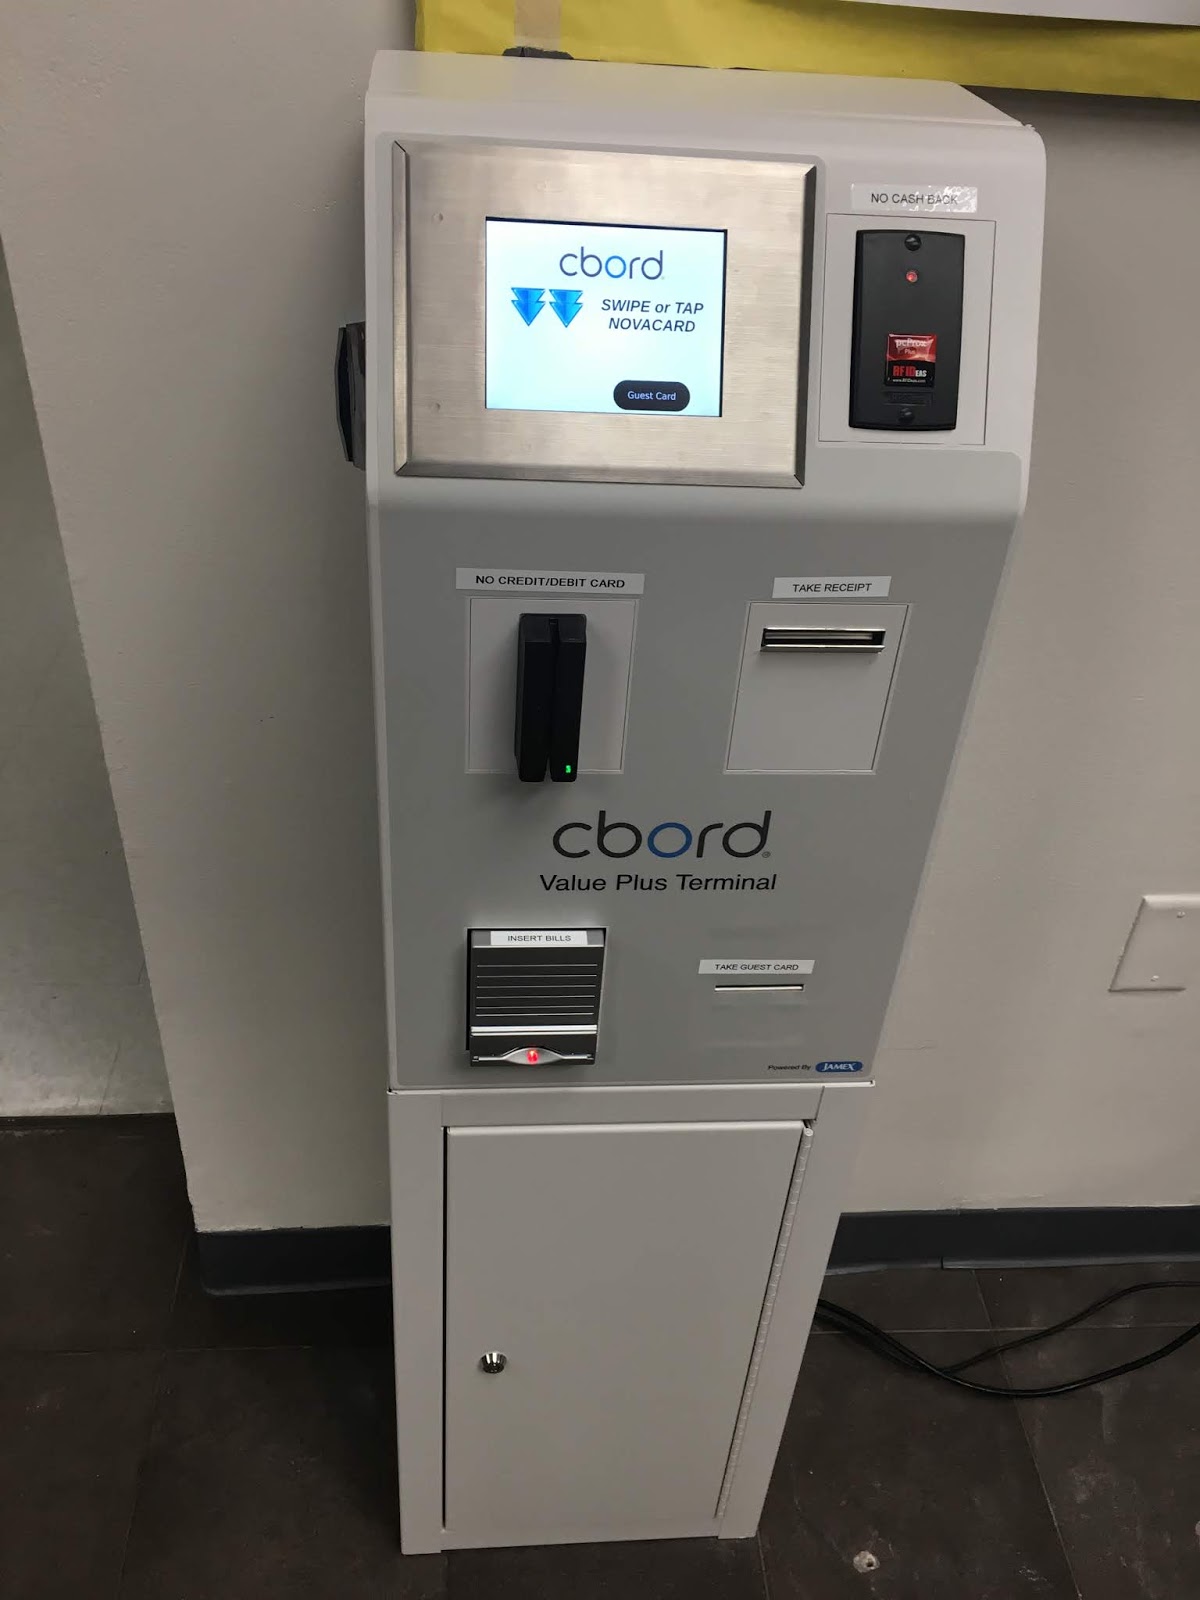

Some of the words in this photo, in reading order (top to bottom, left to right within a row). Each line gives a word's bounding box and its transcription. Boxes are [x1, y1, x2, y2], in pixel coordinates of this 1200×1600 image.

[870, 193, 889, 204] NO
[891, 193, 924, 204] CASH
[927, 194, 958, 205] BACK
[559, 246, 664, 280] cbord
[601, 298, 651, 313] SWIPE
[654, 302, 670, 314] or
[675, 302, 704, 315] TAP
[608, 317, 696, 332] NOVACARD
[627, 390, 653, 401] Guest
[656, 391, 677, 401] Card
[475, 575, 495, 585] NO
[498, 576, 587, 587] CREDIT/DEBIT
[590, 578, 625, 588] CARD
[792, 583, 822, 593] TAKE
[824, 582, 873, 592] RECEIPT
[552, 810, 772, 859] cbord
[540, 874, 607, 891] Value
[615, 873, 668, 891] Plus
[676, 873, 777, 891] Terminal
[821, 1063, 857, 1071] JAMEX
